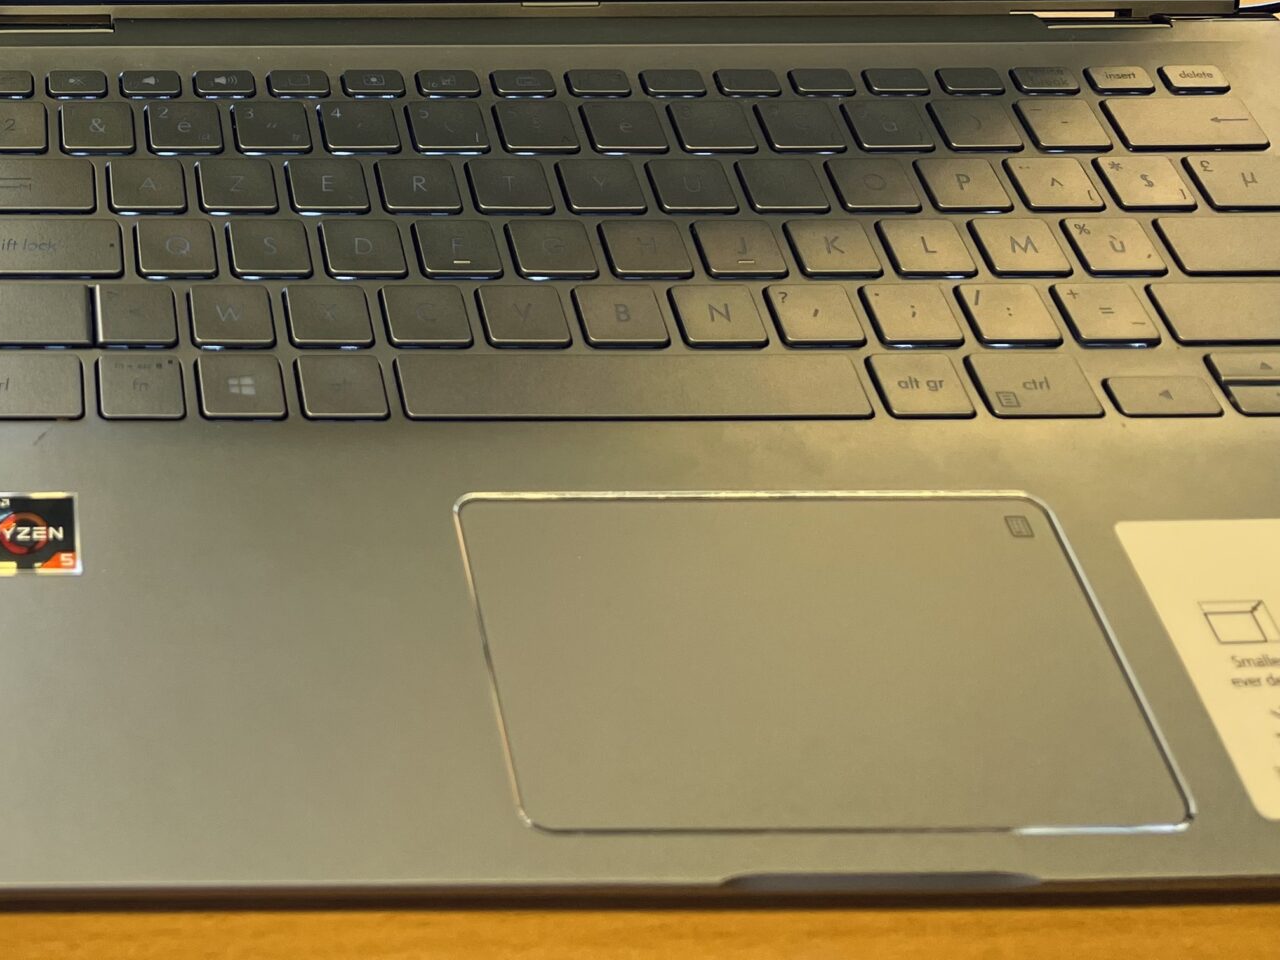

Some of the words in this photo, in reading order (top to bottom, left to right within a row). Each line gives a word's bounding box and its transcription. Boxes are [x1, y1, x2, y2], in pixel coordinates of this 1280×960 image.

[1104, 70, 1137, 81] insert
[1178, 69, 1214, 80] delete
[897, 375, 920, 390] alt
[926, 377, 945, 392] gr
[1022, 376, 1050, 391] ctrl
[60, 552, 75, 567] 5
